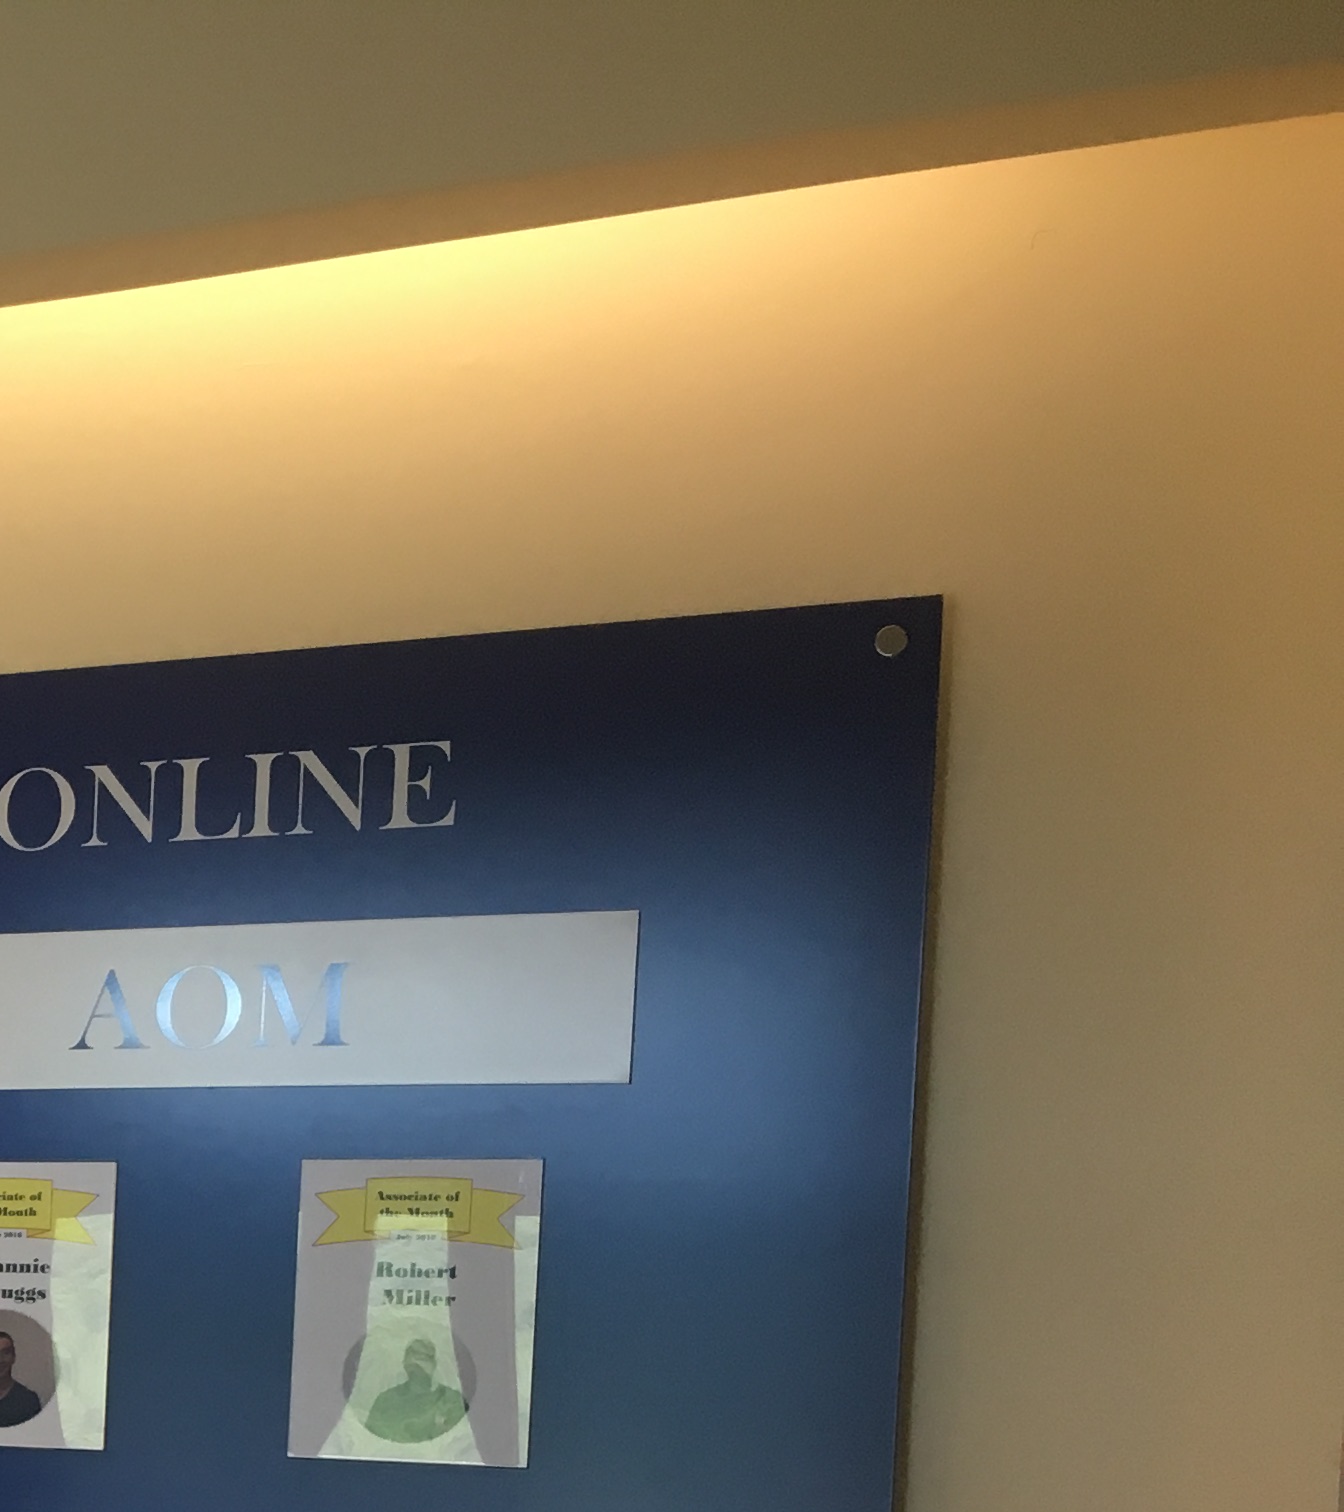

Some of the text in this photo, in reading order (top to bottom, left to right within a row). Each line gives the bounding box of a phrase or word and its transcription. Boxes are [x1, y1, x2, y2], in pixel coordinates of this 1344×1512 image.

[68, 961, 351, 1051] AOM
[29, 1190, 42, 1202] of
[377, 1190, 461, 1202] Associate of
[375, 1261, 458, 1280] Robert
[382, 1289, 456, 1307] Miller
